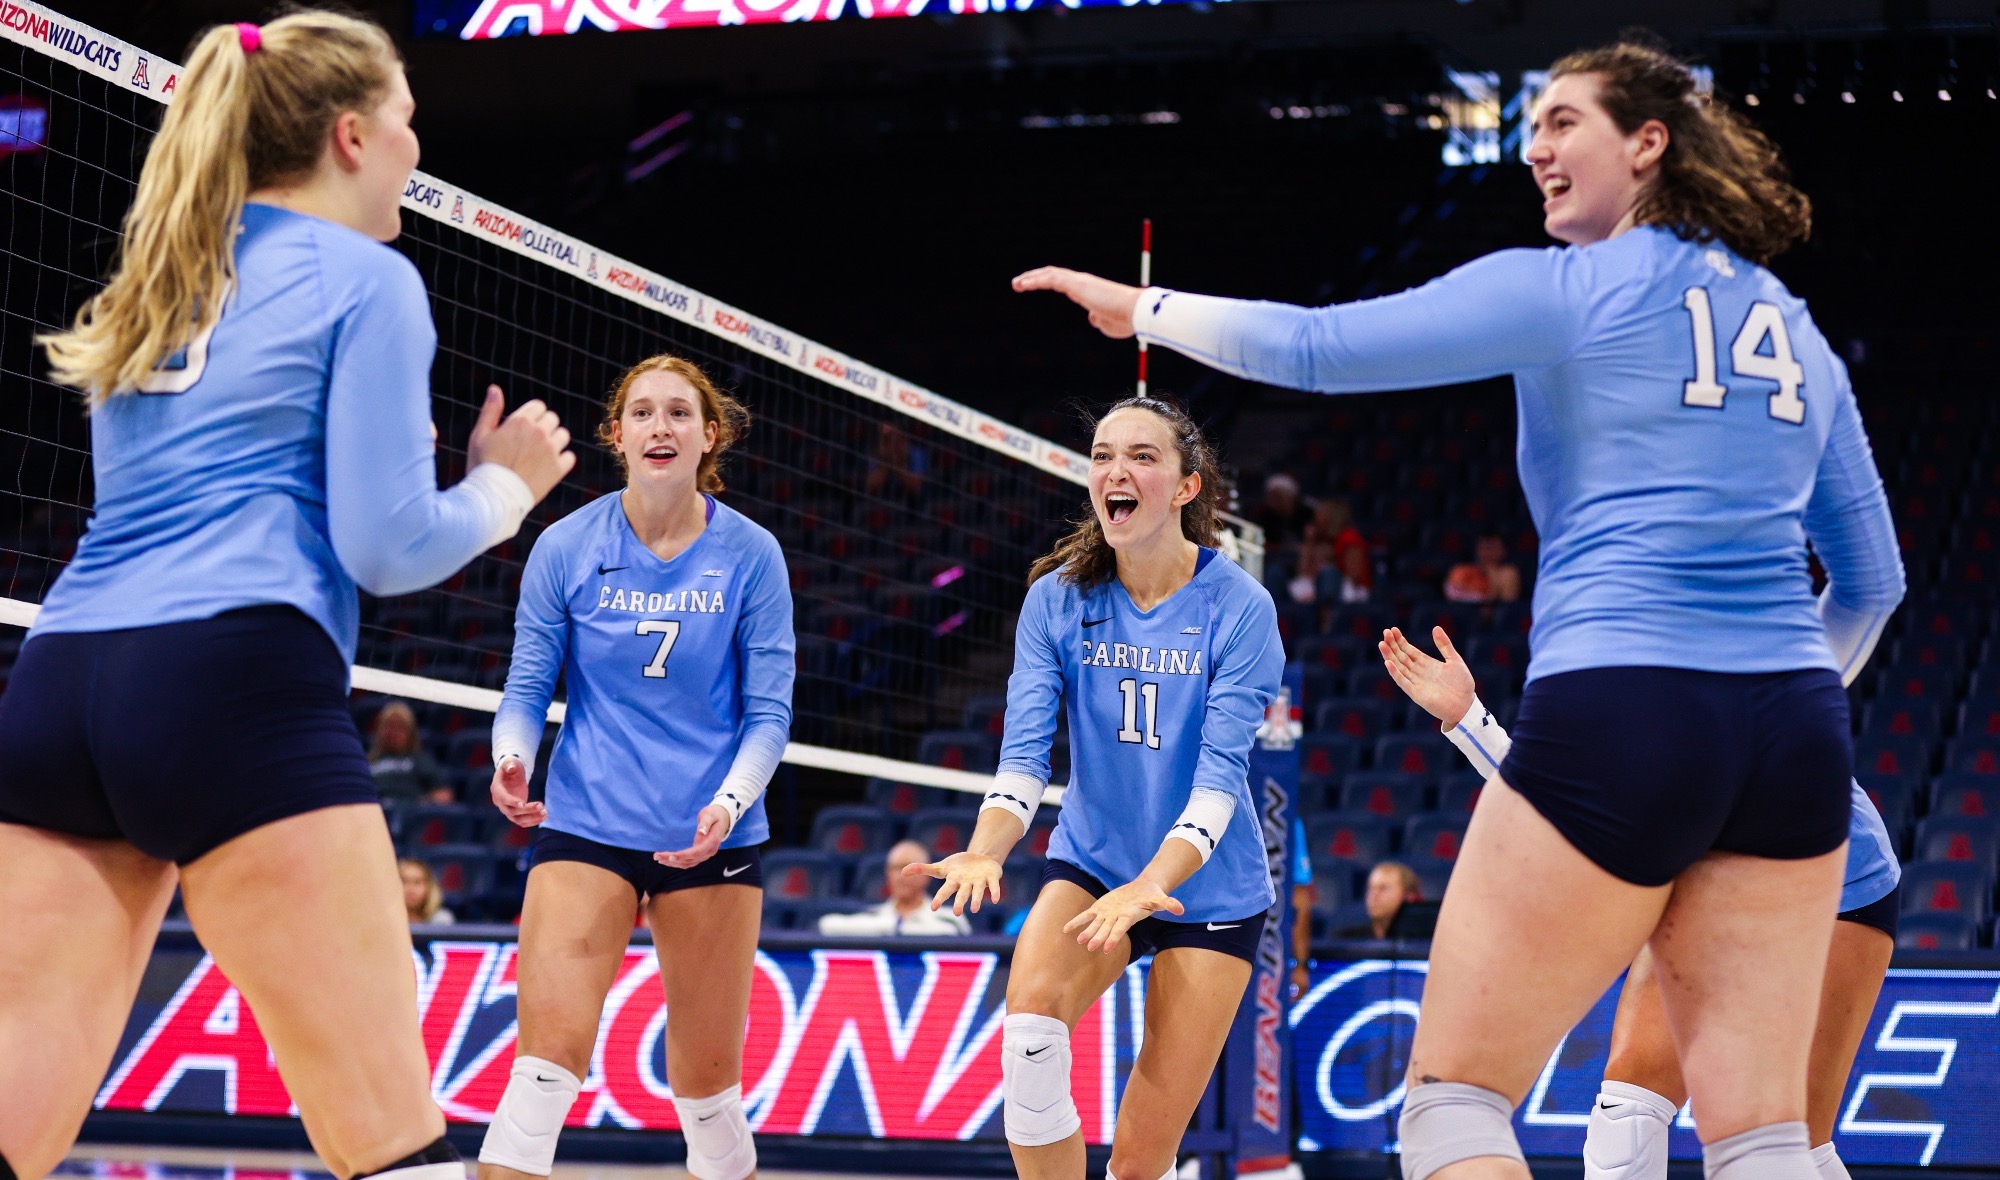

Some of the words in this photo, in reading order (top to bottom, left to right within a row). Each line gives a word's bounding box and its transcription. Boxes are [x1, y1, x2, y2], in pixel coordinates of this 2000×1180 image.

[1682, 285, 1807, 426] 14
[701, 569, 725, 577] ACC
[598, 585, 725, 613] CAROLINA
[1180, 626, 1202, 634] ACC
[635, 619, 681, 679] 7
[1082, 640, 1203, 675] CAROLINA
[1118, 678, 1161, 750] 11
